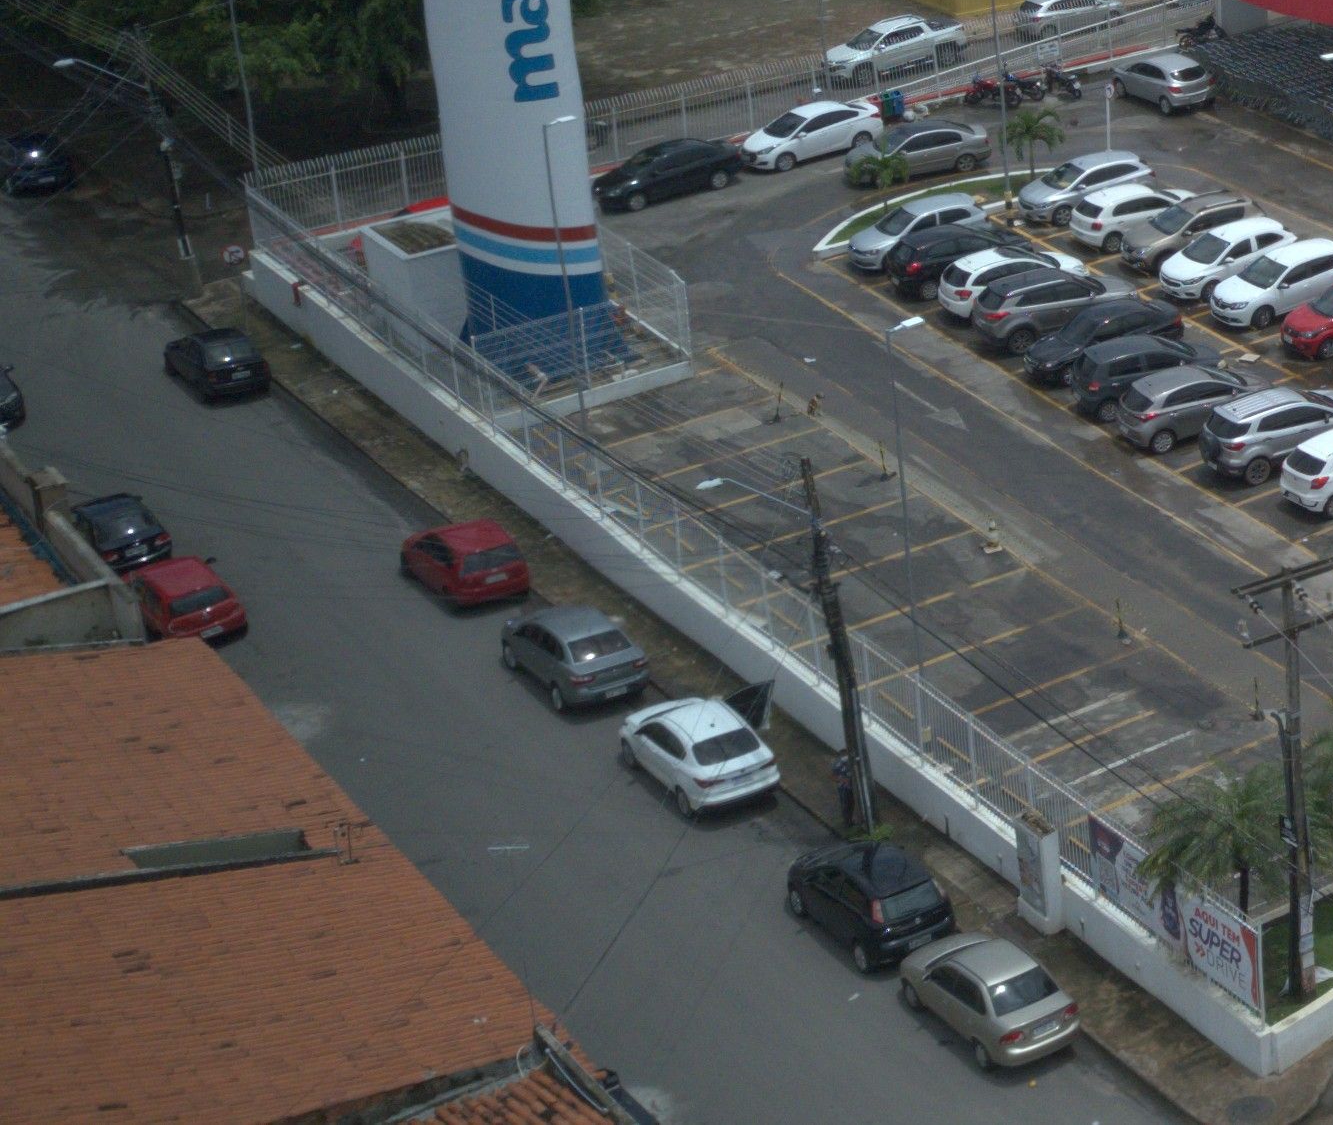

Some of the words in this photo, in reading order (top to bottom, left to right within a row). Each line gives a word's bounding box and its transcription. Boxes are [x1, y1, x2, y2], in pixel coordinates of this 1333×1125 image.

[1189, 917, 1242, 969] SUPER
[1194, 907, 1219, 931] AQUI
[1221, 923, 1241, 945] TEM
[1206, 948, 1248, 992] DRIVE
